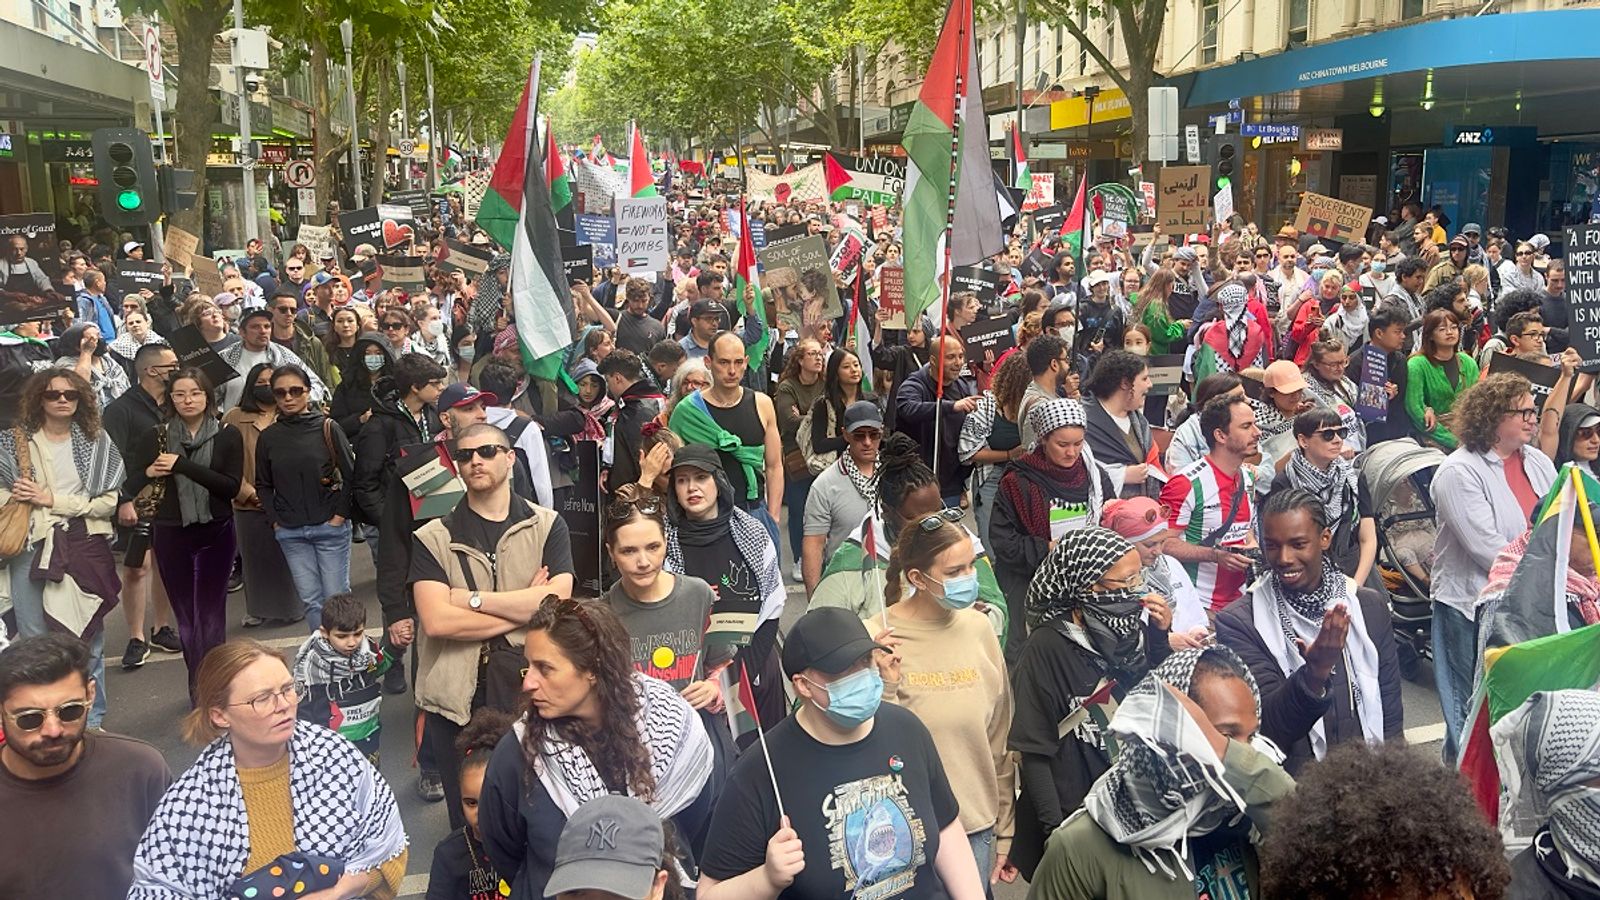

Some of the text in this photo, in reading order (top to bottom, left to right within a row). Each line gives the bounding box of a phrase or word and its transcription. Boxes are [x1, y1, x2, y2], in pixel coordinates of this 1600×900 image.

[1311, 65, 1347, 79] CHINATOWN
[1349, 58, 1388, 73] MELBOURNE
[1266, 125, 1290, 133] Bourke
[1456, 131, 1481, 143] ANZ
[1336, 214, 1363, 229] CEDED
[630, 224, 652, 236] NOT
[621, 240, 663, 254] BOMBS
[831, 239, 851, 268] STOP
[802, 250, 822, 262] SOUL
[1569, 269, 1593, 285] WITH
[1570, 288, 1581, 304] IN
[1574, 308, 1585, 322] IS
[967, 329, 1009, 344] CEASEFIRE
[981, 338, 997, 347] NOW
[586, 818, 621, 850] NY
